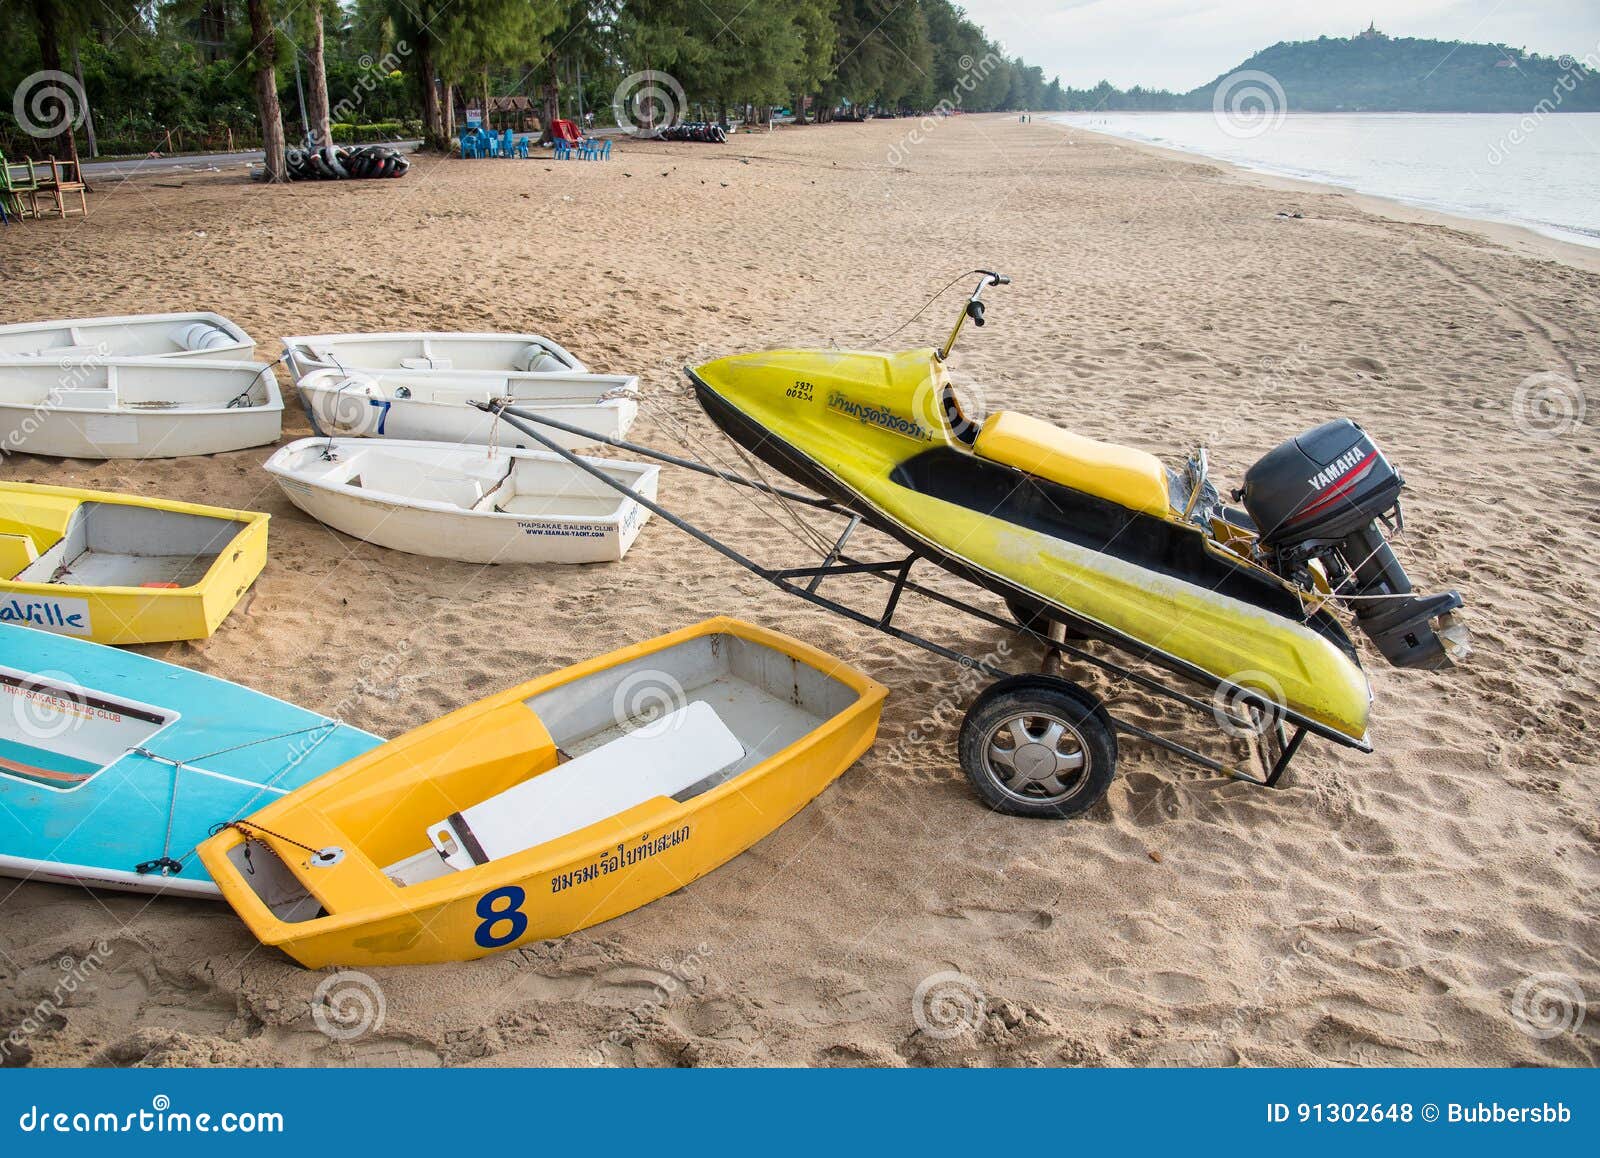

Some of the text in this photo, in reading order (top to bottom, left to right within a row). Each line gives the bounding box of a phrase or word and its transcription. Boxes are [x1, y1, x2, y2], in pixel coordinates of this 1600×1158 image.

[369, 399, 392, 435] 7
[1308, 446, 1366, 491] YAMAHA
[517, 522, 562, 530] THAPSAKAE
[2, 684, 57, 707] THAPSAKAE
[60, 700, 95, 716] SAILING
[97, 711, 121, 722] CLUB
[474, 885, 529, 949] 8
